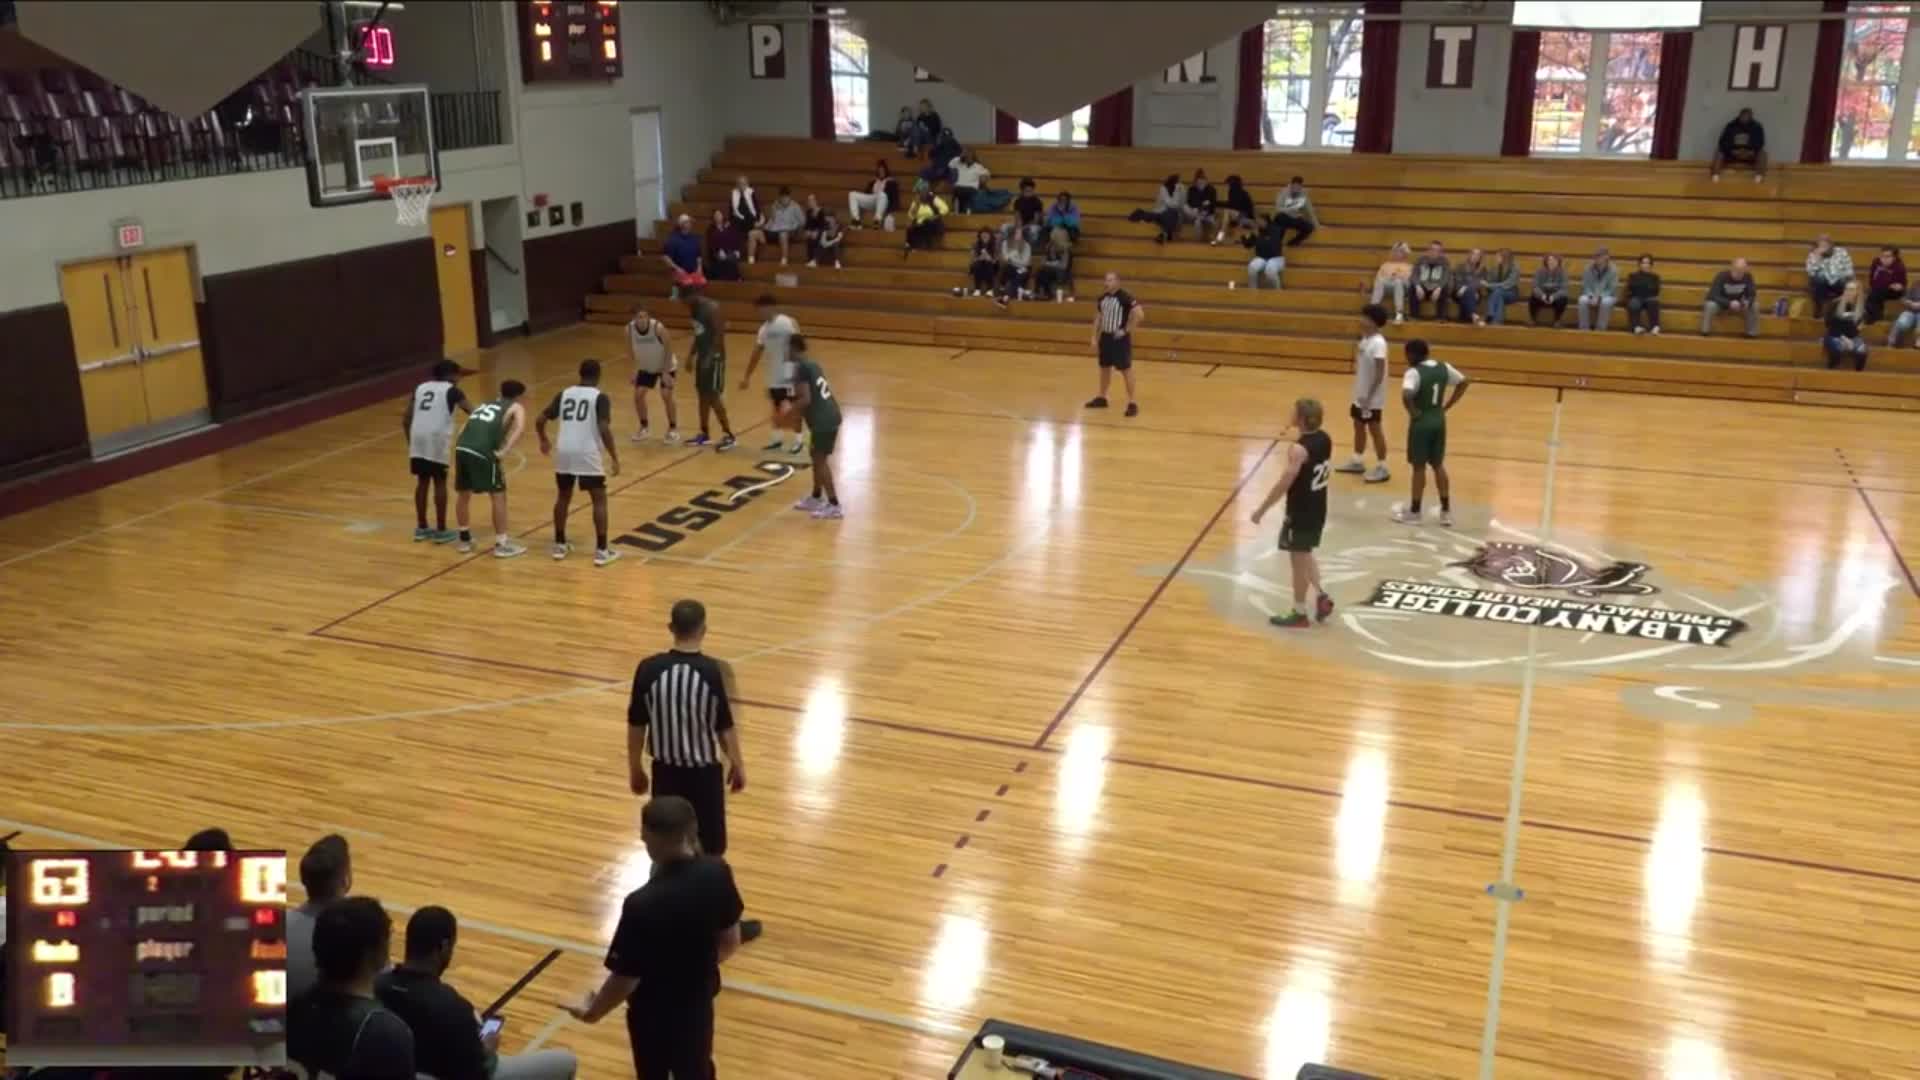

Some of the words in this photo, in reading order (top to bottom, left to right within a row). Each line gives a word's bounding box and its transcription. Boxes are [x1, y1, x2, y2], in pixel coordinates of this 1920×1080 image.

[752, 25, 782, 76] P
[1434, 27, 1472, 84] T
[1733, 26, 1782, 88] H
[419, 391, 435, 410] 2
[1431, 383, 1440, 405] 1
[562, 399, 589, 421] 20
[1382, 581, 1476, 600] SCIENCES
[1477, 592, 1560, 609] HEALTH
[1374, 591, 1541, 624] COLLEGE
[1588, 603, 1713, 625] PHARMACY
[1544, 610, 1728, 645] ALBANY
